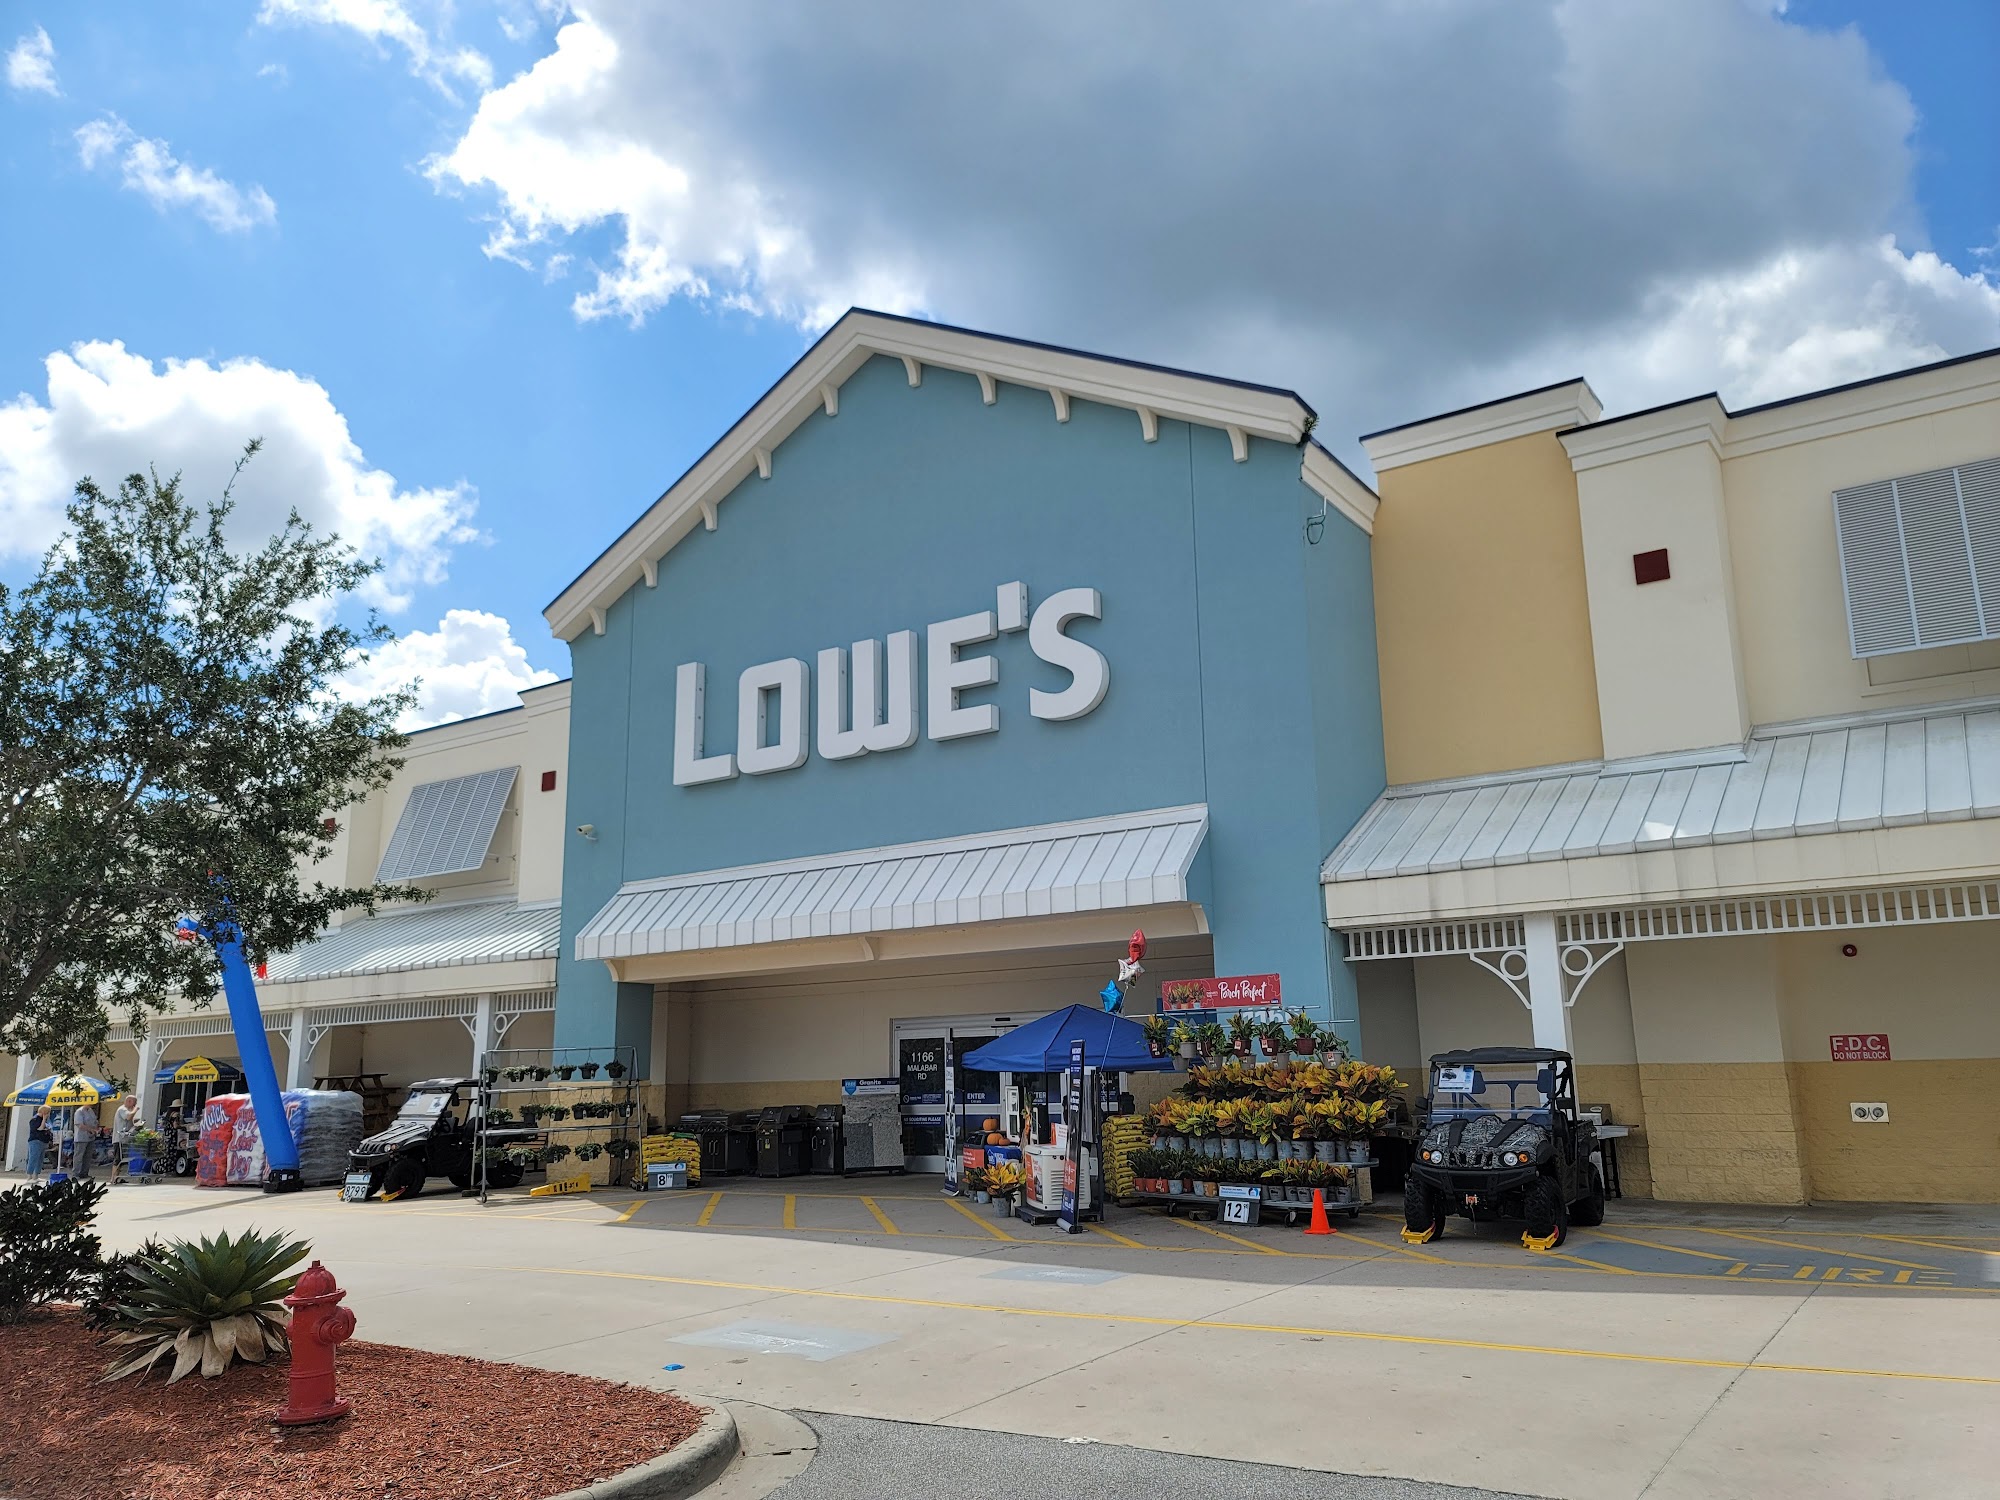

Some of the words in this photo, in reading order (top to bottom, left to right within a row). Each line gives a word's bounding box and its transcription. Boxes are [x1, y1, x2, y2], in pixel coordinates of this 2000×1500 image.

[673, 580, 1111, 787] LOWE'S
[1218, 981, 1240, 1000] Porch
[1240, 979, 1267, 1001] Perfect
[1832, 1035, 1886, 1051] F.D.C.
[911, 1051, 934, 1063] 1166
[1834, 1052, 1845, 1060] DO
[1846, 1051, 1861, 1060] NOT
[1863, 1051, 1888, 1060] BLOCK
[907, 1064, 938, 1072] MALABAR
[177, 1073, 215, 1081] SABRETT
[917, 1072, 927, 1080] RD
[51, 1094, 96, 1103] SABRETT
[967, 1092, 986, 1100] ENTER
[1724, 1261, 1957, 1286] FIRE
